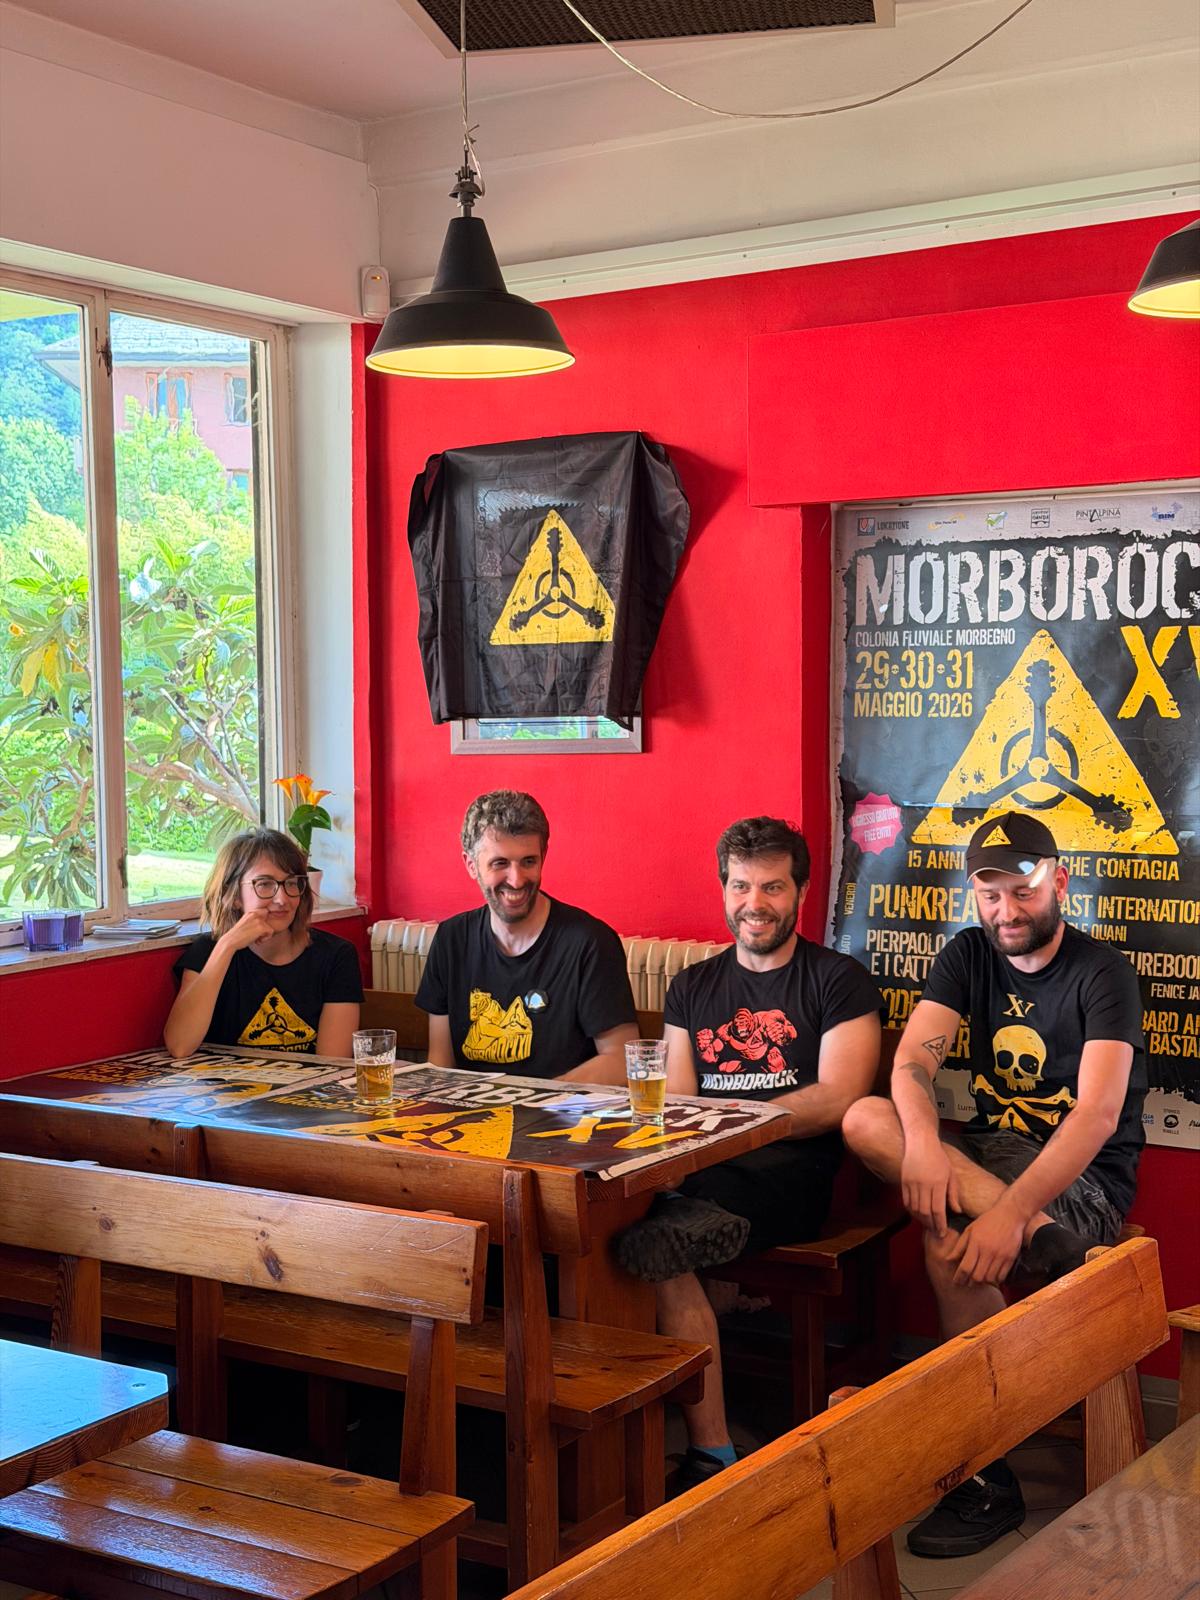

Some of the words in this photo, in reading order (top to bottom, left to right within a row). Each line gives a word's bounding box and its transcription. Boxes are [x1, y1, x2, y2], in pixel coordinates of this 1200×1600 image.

[855, 630, 899, 647] COLONIA
[902, 629, 953, 647] FLUVIALE
[955, 627, 1016, 646] MORBEGNO
[1117, 625, 1200, 719] X
[854, 691, 923, 718] MAGGIO
[927, 692, 973, 718] 2026
[907, 850, 922, 868] 15
[926, 850, 965, 870] ANNI
[1095, 857, 1180, 881] CONTAGIA
[865, 929, 947, 956] PIERPAOLO
[871, 952, 881, 976] E
[884, 953, 889, 976] I
[1151, 982, 1187, 1000] FENICE
[1002, 993, 1035, 1018] XV
[1149, 1032, 1200, 1059] BASTA
[701, 1069, 799, 1091] MORBOROCK
